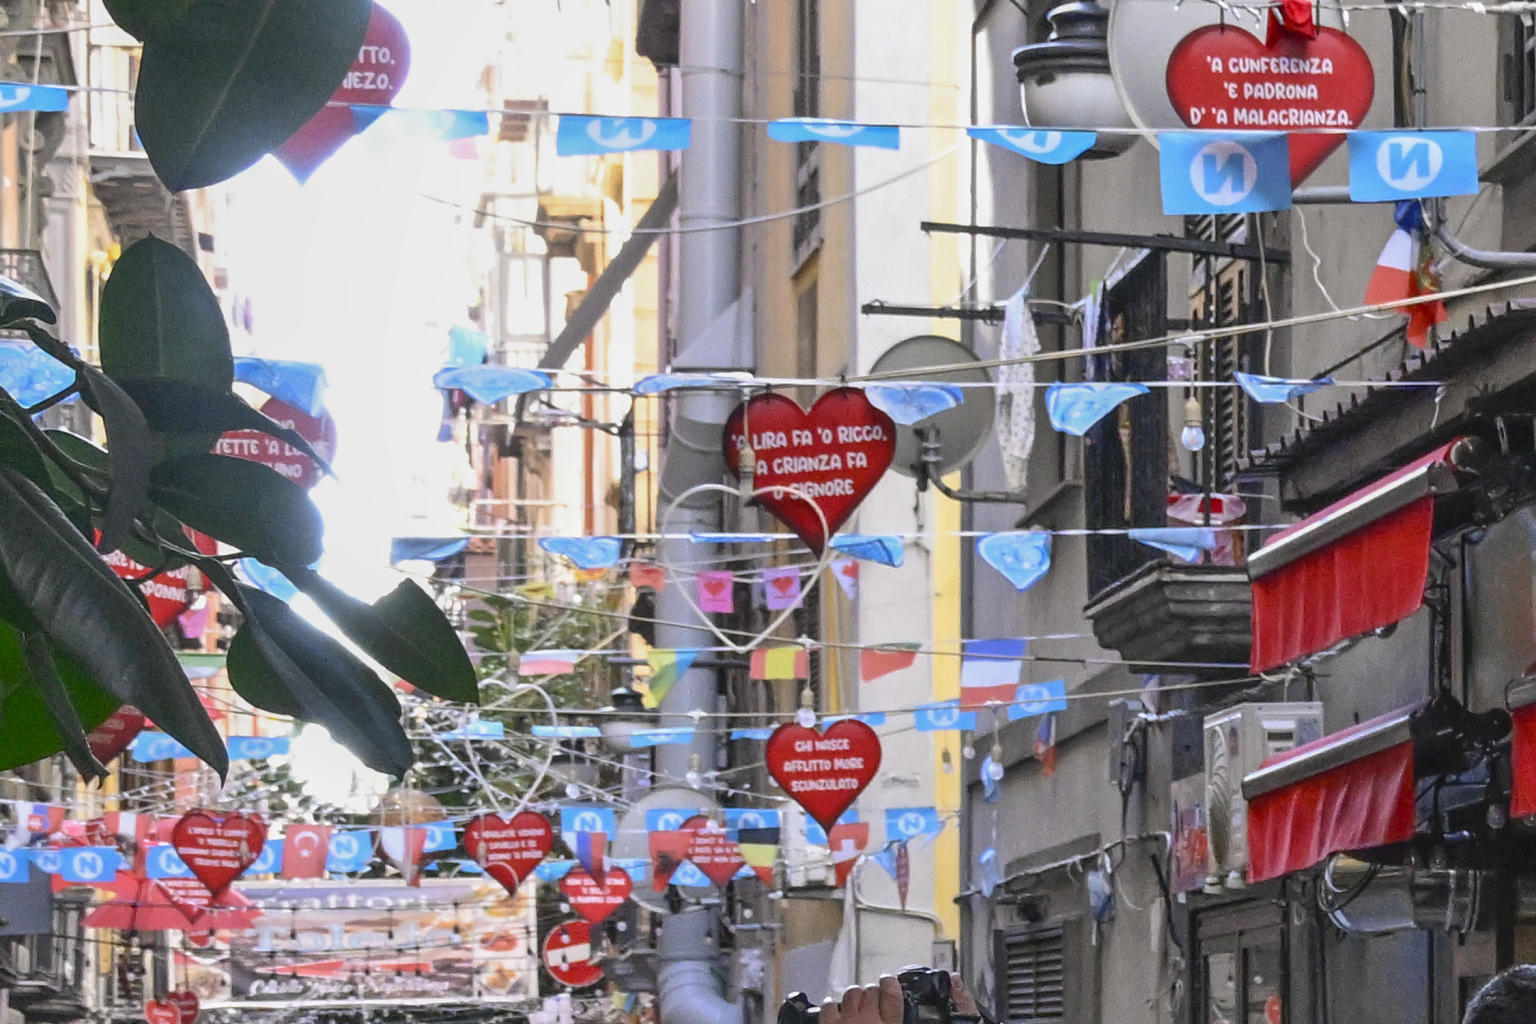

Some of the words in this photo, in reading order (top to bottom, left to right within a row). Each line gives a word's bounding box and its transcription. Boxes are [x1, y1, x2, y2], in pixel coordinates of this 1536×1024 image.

[1207, 56, 1223, 73] 'A
[1229, 57, 1333, 74] CUNFERENZA
[1224, 82, 1238, 98] 'E
[1244, 83, 1317, 99] PADRONA
[1212, 108, 1227, 124] 'A
[1234, 108, 1353, 125] MALACRIANZA.
[752, 432, 788, 450] LIRA
[792, 430, 813, 446] FA
[817, 427, 832, 444] 'O
[773, 454, 842, 474] CRIANZA
[847, 452, 868, 468] FA
[789, 479, 855, 500] SIGNORE
